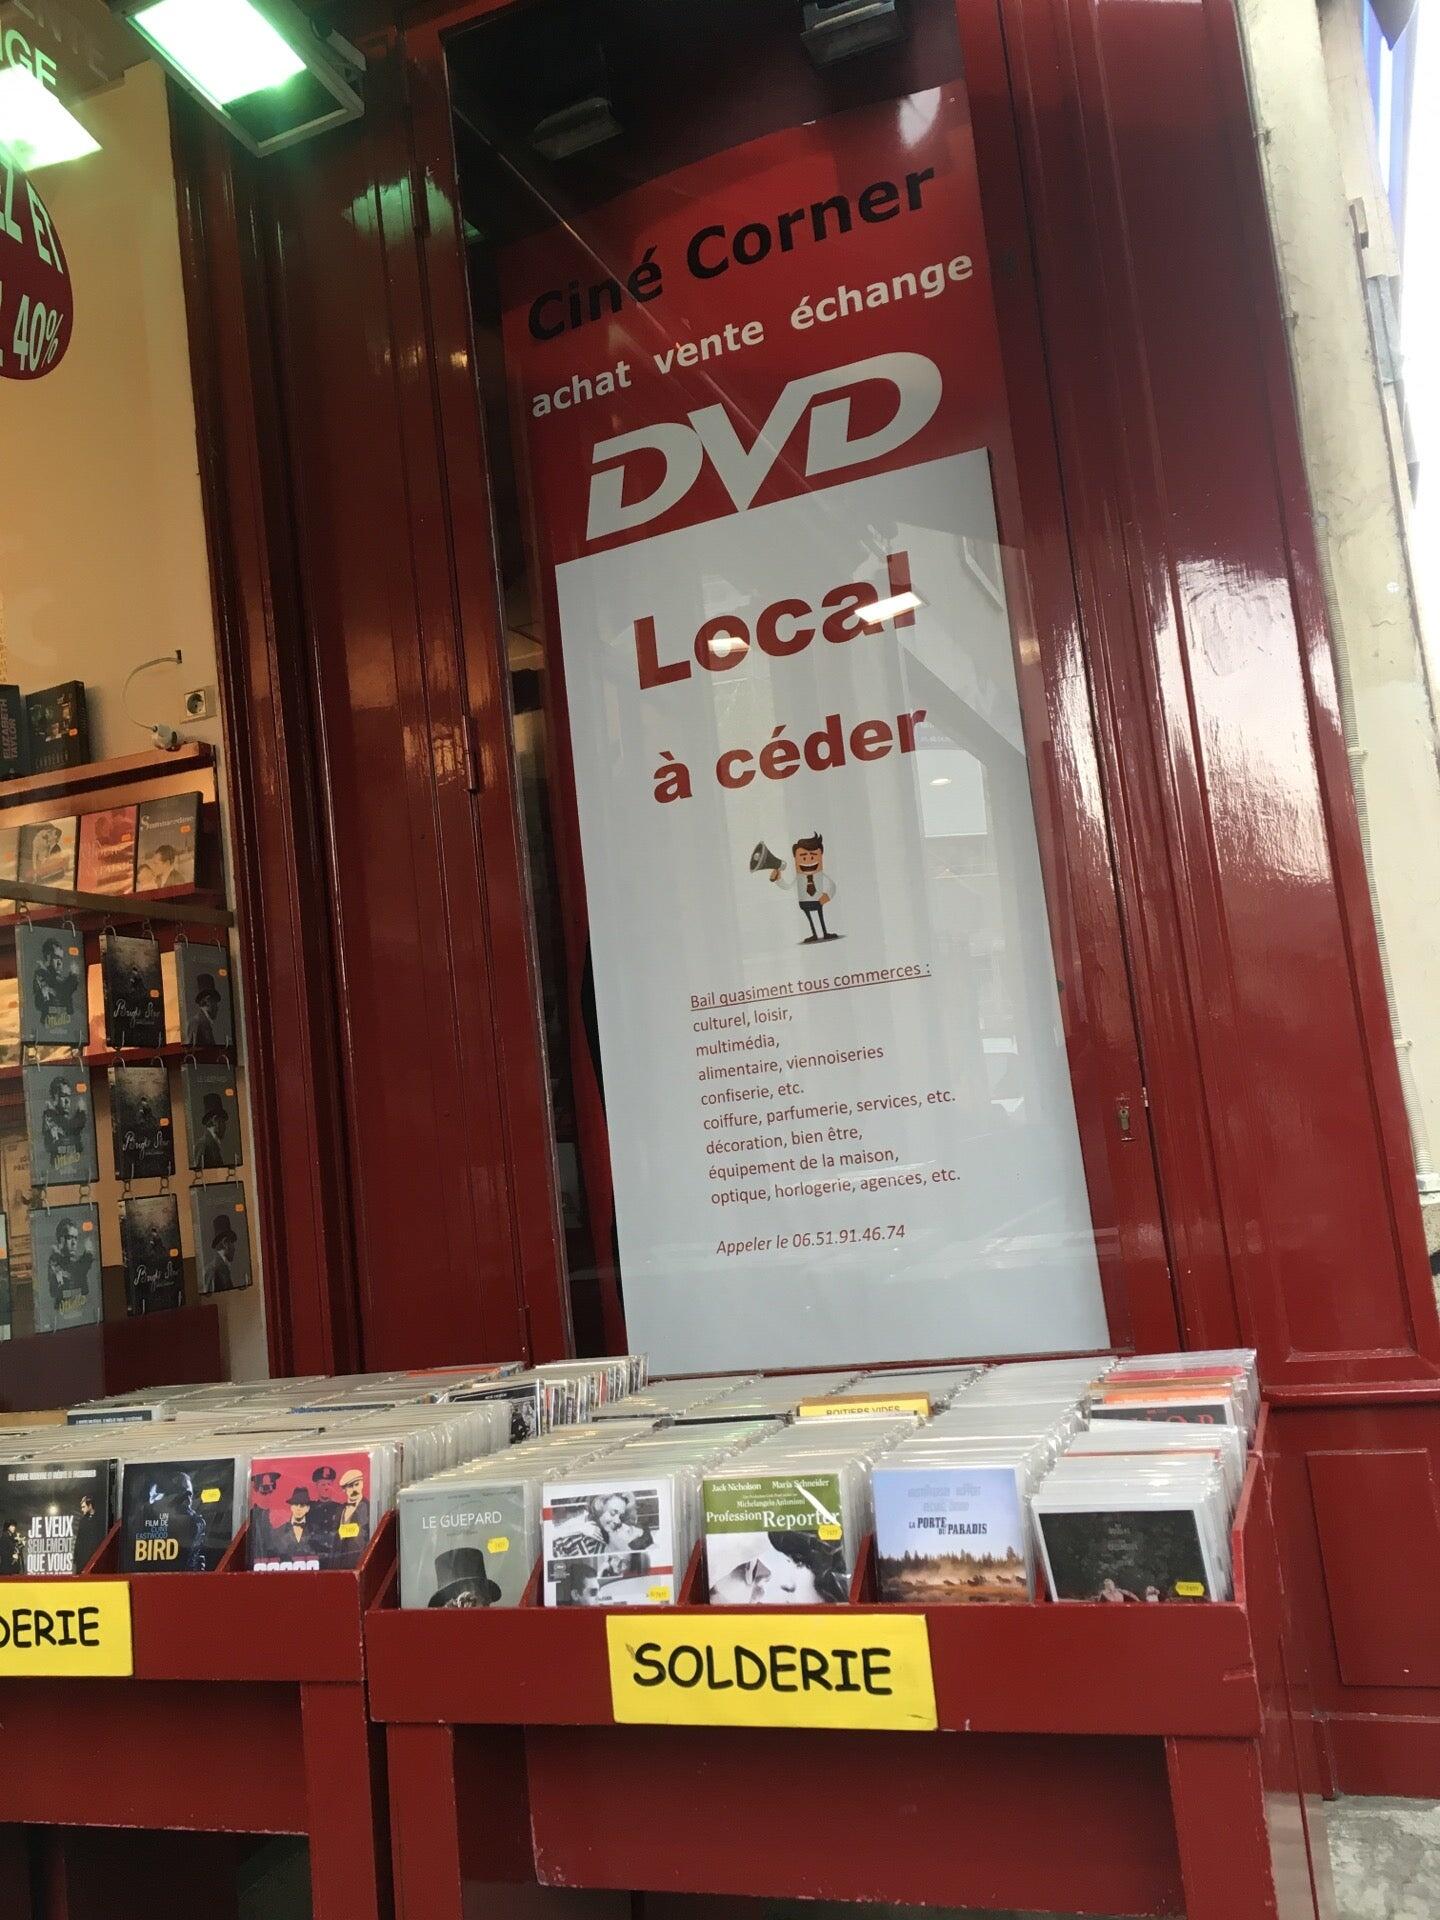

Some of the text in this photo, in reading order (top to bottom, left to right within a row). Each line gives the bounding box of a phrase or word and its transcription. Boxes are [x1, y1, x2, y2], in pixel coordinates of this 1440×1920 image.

[26, 179, 63, 274] ET
[528, 167, 934, 341] Ciné Corner
[13, 294, 64, 372] 40%
[531, 254, 974, 418] achat vente échange
[585, 351, 944, 542] DVD
[633, 550, 916, 690] Local
[653, 708, 927, 804] à céder
[691, 992, 716, 1009] Bail
[719, 980, 794, 1007] quasiment
[798, 978, 830, 993] tous
[833, 963, 921, 987] commerces
[693, 1006, 793, 1032] culturel, loisir,
[695, 1033, 780, 1057] multimédia,
[698, 1046, 884, 1082] alimentaire, viennoiseries
[701, 1082, 804, 1106] confiserie, etc.
[703, 1090, 956, 1131] coiffure, parfumerie, services, etc.
[706, 1126, 863, 1155] décoration, bien être,
[708, 1149, 899, 1180] équipement de la maison,
[711, 1167, 961, 1206] optique, horlogerie, agences, etc.
[716, 1224, 906, 1257] Appeler le 06.51.91.46.74
[712, 1482, 762, 1492] Jack Nicholson
[772, 1479, 830, 1489] Maria Schneider
[28, 1515, 74, 1538] JE VEUX
[422, 1511, 502, 1529] LE GUEPARD
[706, 1510, 762, 1522] Profession
[917, 1517, 947, 1529] PORTE
[948, 1523, 988, 1535] PARADIS
[28, 1537, 74, 1553] SEULEMENT
[135, 1538, 179, 1561] BIRD
[27, 1552, 73, 1573] QUE VOUS
[633, 1642, 893, 1695] SOLDERIE
